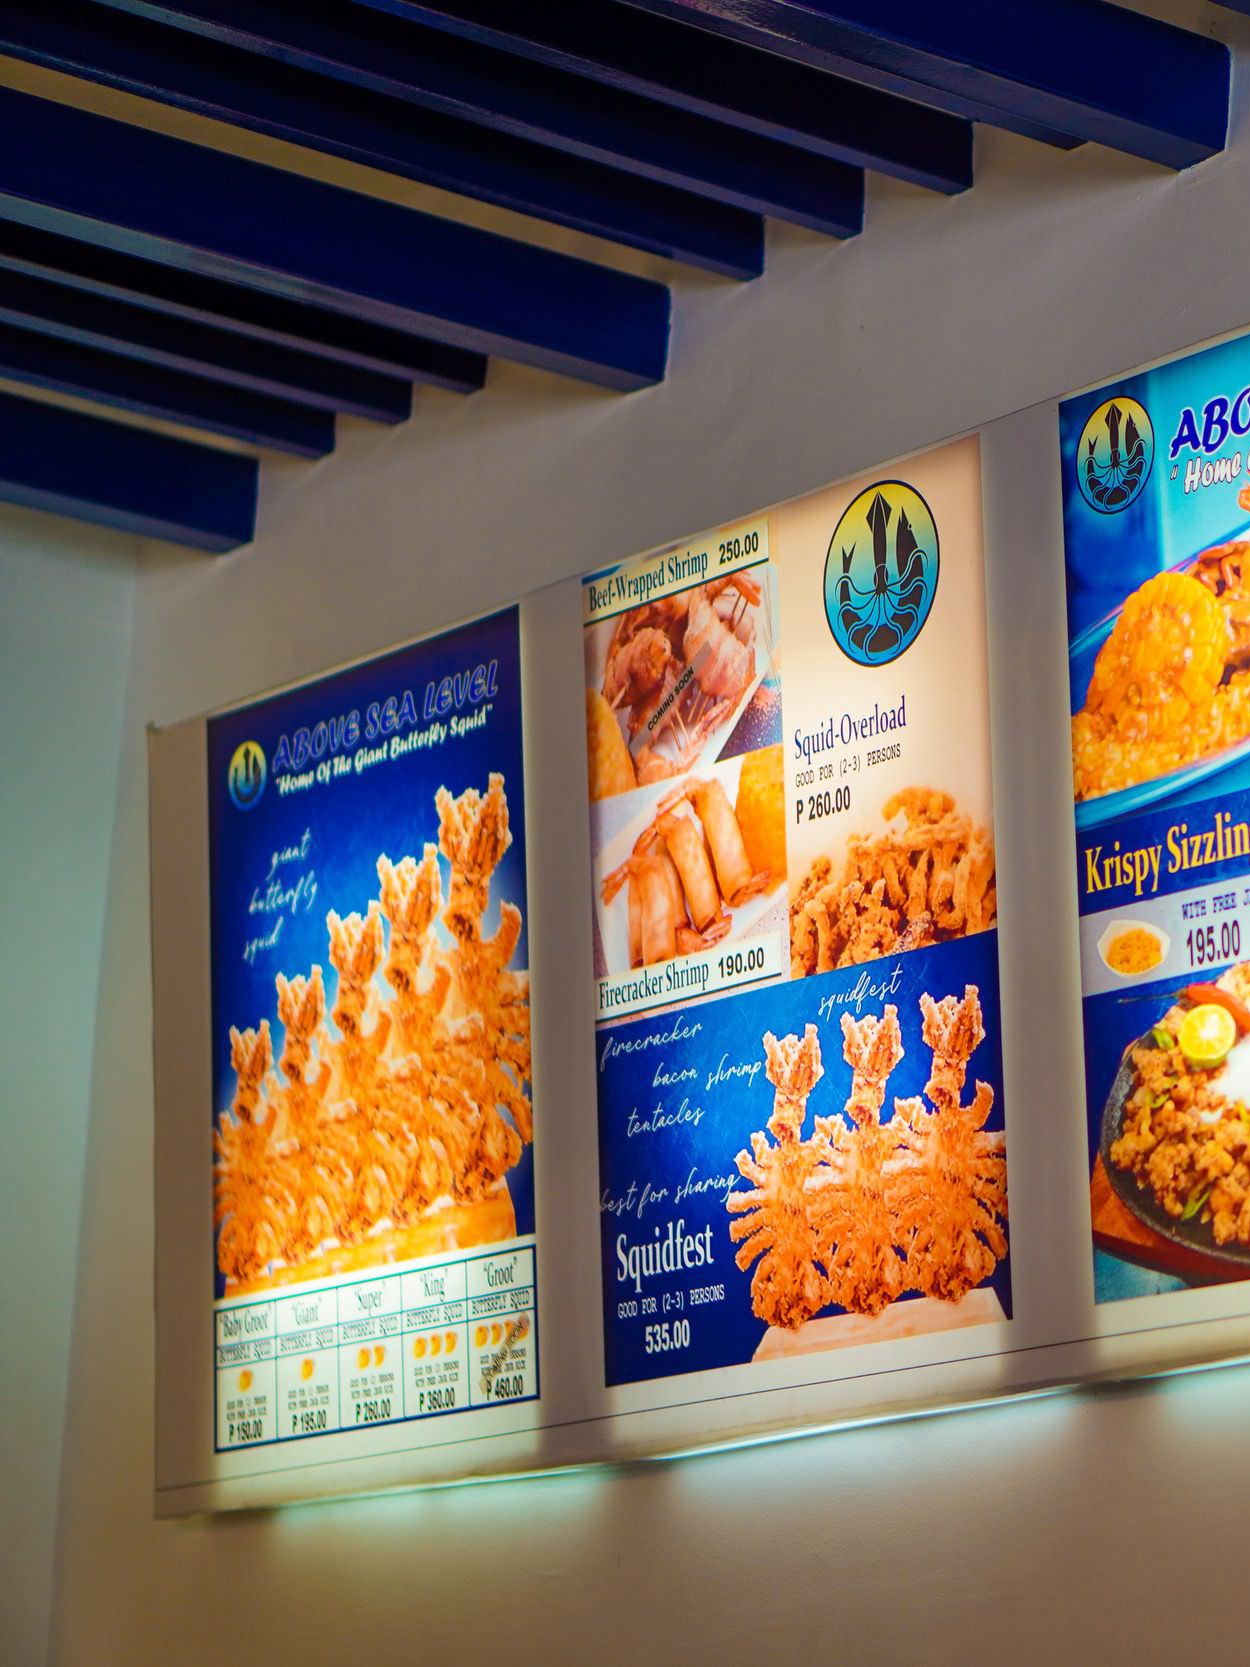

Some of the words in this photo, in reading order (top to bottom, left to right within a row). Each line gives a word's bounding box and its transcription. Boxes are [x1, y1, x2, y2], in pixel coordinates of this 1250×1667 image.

[589, 562, 664, 612] Beef-Wrapped
[668, 551, 708, 589] Shrimp
[719, 531, 759, 563] 250.00
[272, 710, 360, 772] ABOVE
[365, 689, 418, 739] SEA
[423, 659, 499, 721] LEVEL
[648, 694, 675, 731] COMING
[674, 667, 694, 694] SOON
[316, 761, 331, 784] Of
[332, 753, 352, 776] The
[354, 743, 388, 774] Giant
[390, 721, 447, 761] Butterfly
[795, 695, 907, 764] Squid-Overload
[796, 770, 814, 788] GOOD
[819, 764, 833, 781] FOR
[840, 755, 860, 777] (2-3)
[867, 743, 901, 766] PERSONS
[796, 800, 804, 824] P
[809, 786, 850, 821] 260.00
[266, 828, 311, 880] giant
[1085, 841, 1162, 896] Krispy
[249, 870, 318, 915] butterfly
[1182, 900, 1207, 920] WITH
[1213, 894, 1236, 913] FREE
[243, 917, 283, 964] squid
[1187, 919, 1240, 966] 195.00
[599, 970, 663, 1009] Firecracker
[666, 959, 709, 992] Shrimp
[718, 947, 764, 978] 190.00
[818, 962, 903, 1021] squidfest
[601, 1016, 703, 1072] firecracker
[653, 1062, 697, 1088] bacon
[706, 1053, 761, 1091] shrimp
[627, 1098, 705, 1137] tentacles
[600, 1180, 637, 1217] best
[637, 1183, 668, 1218] for
[675, 1167, 740, 1204] sharing
[617, 1219, 714, 1293] Squidfest
[618, 1302, 637, 1318] GOOD
[642, 1298, 657, 1314] FOR
[663, 1291, 684, 1313] (2-3)
[690, 1284, 724, 1305] PERSONS
[645, 1319, 690, 1354] 535.00
[427, 1387, 455, 1411] 360.00
[495, 1375, 524, 1398] 460.00
